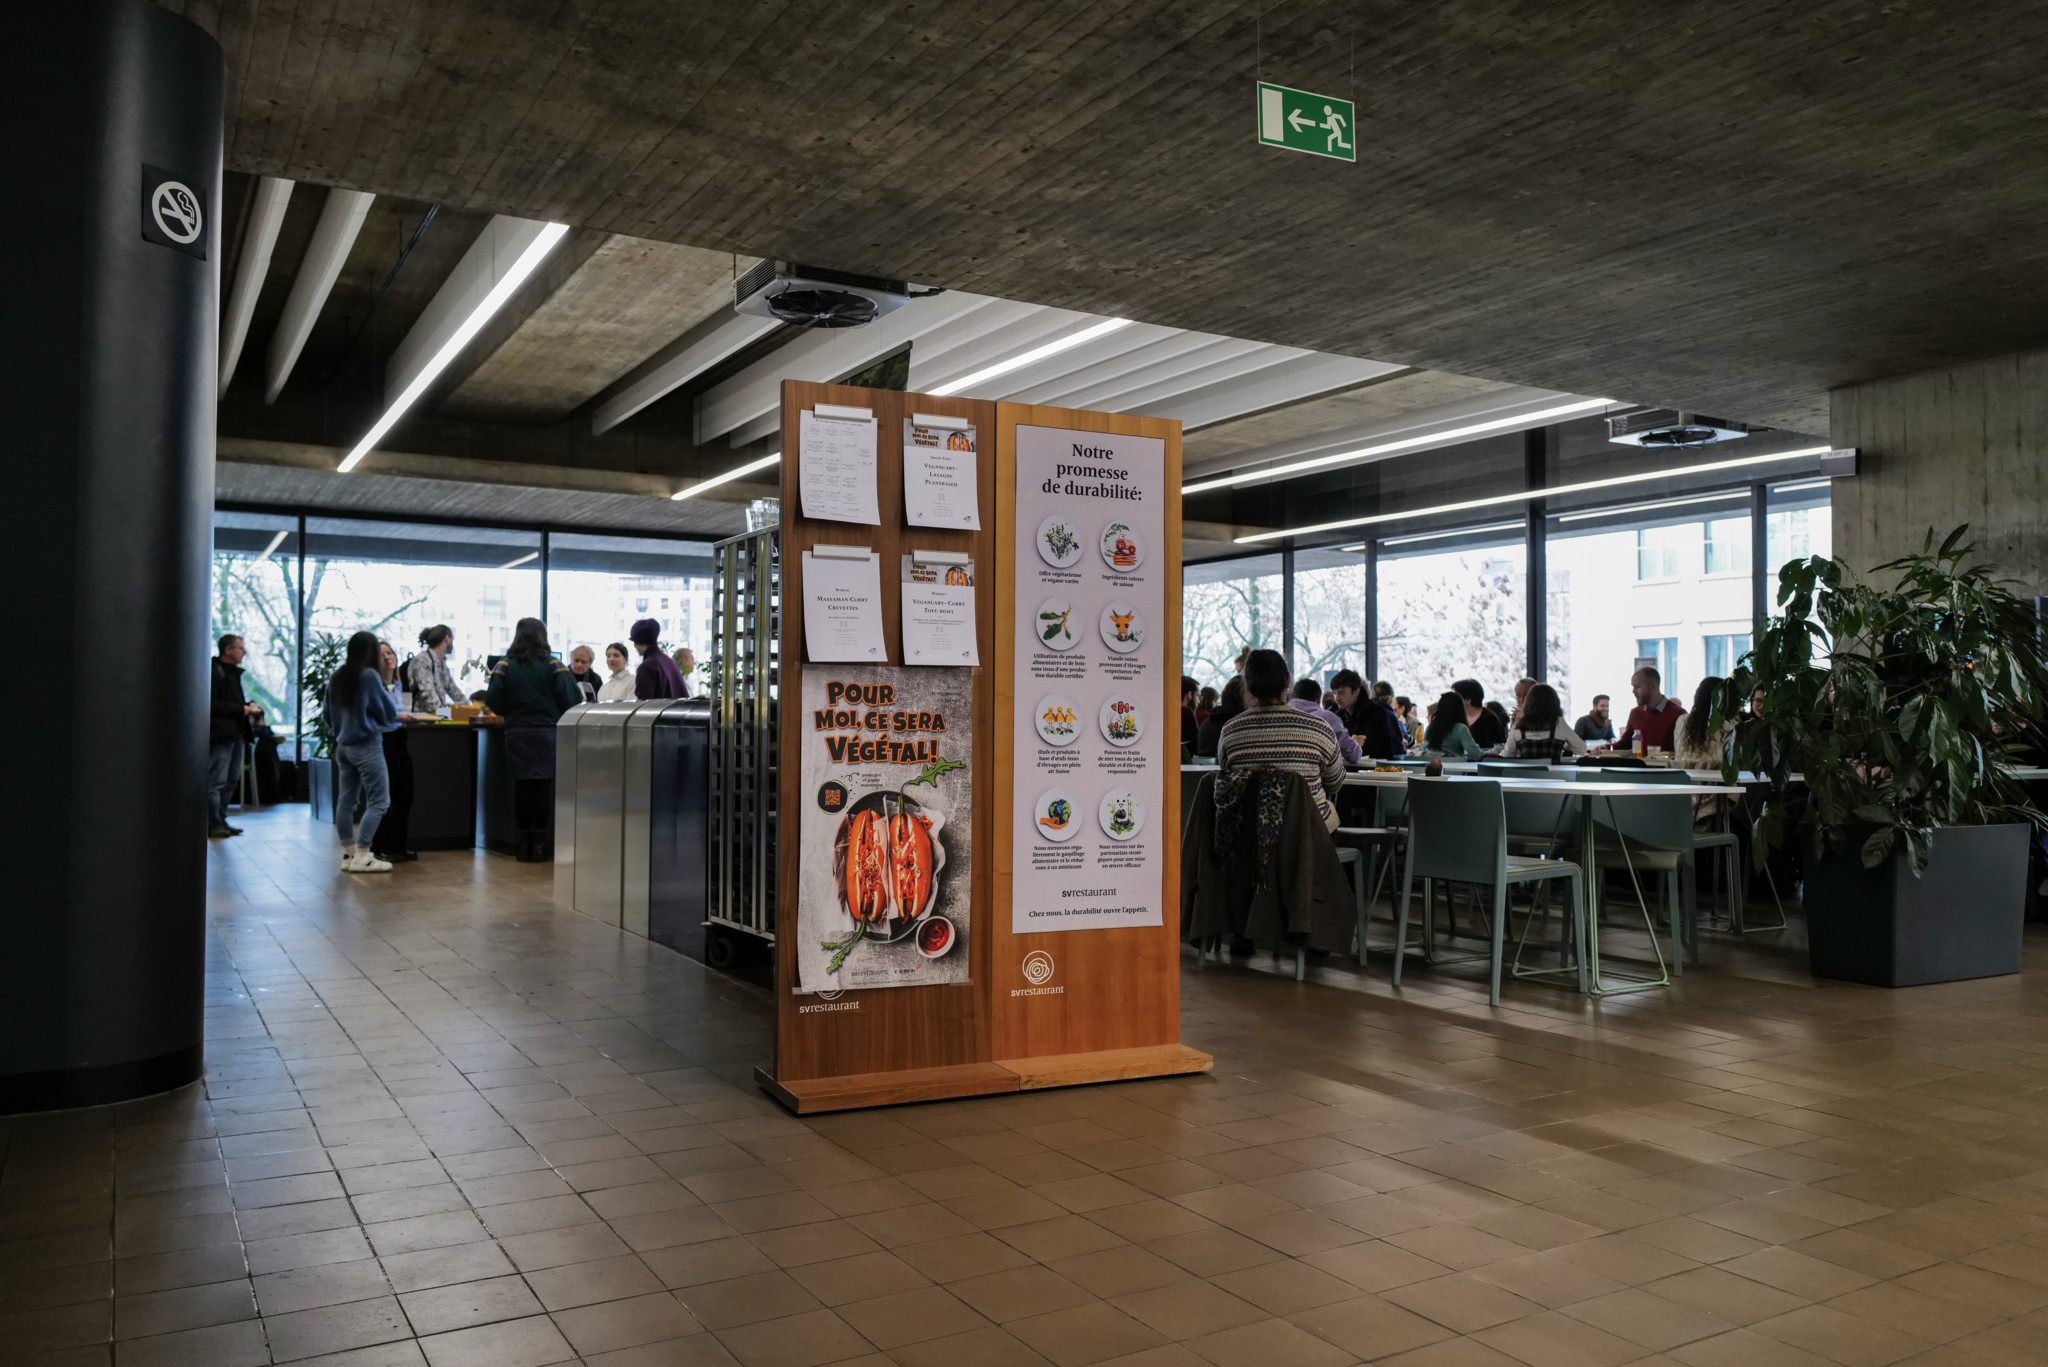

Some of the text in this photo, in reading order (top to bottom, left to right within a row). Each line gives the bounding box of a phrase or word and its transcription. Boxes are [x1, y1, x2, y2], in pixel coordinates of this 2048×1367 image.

[1072, 444, 1114, 460] Notre
[1056, 464, 1129, 480] promesse
[925, 479, 958, 488] PLANTBASED
[1042, 478, 1142, 501] de durabilité:
[827, 680, 896, 707] POUR
[814, 708, 947, 733] MOI, CE SERA
[825, 732, 939, 765] VÉGÉTAL!
[1062, 888, 1117, 898] svrestaurant
[1072, 907, 1102, 915] durabilité
[1122, 906, 1149, 915] l'appétit.
[1011, 985, 1064, 997] svrestaurant
[800, 1001, 860, 1014] svrestaurant
